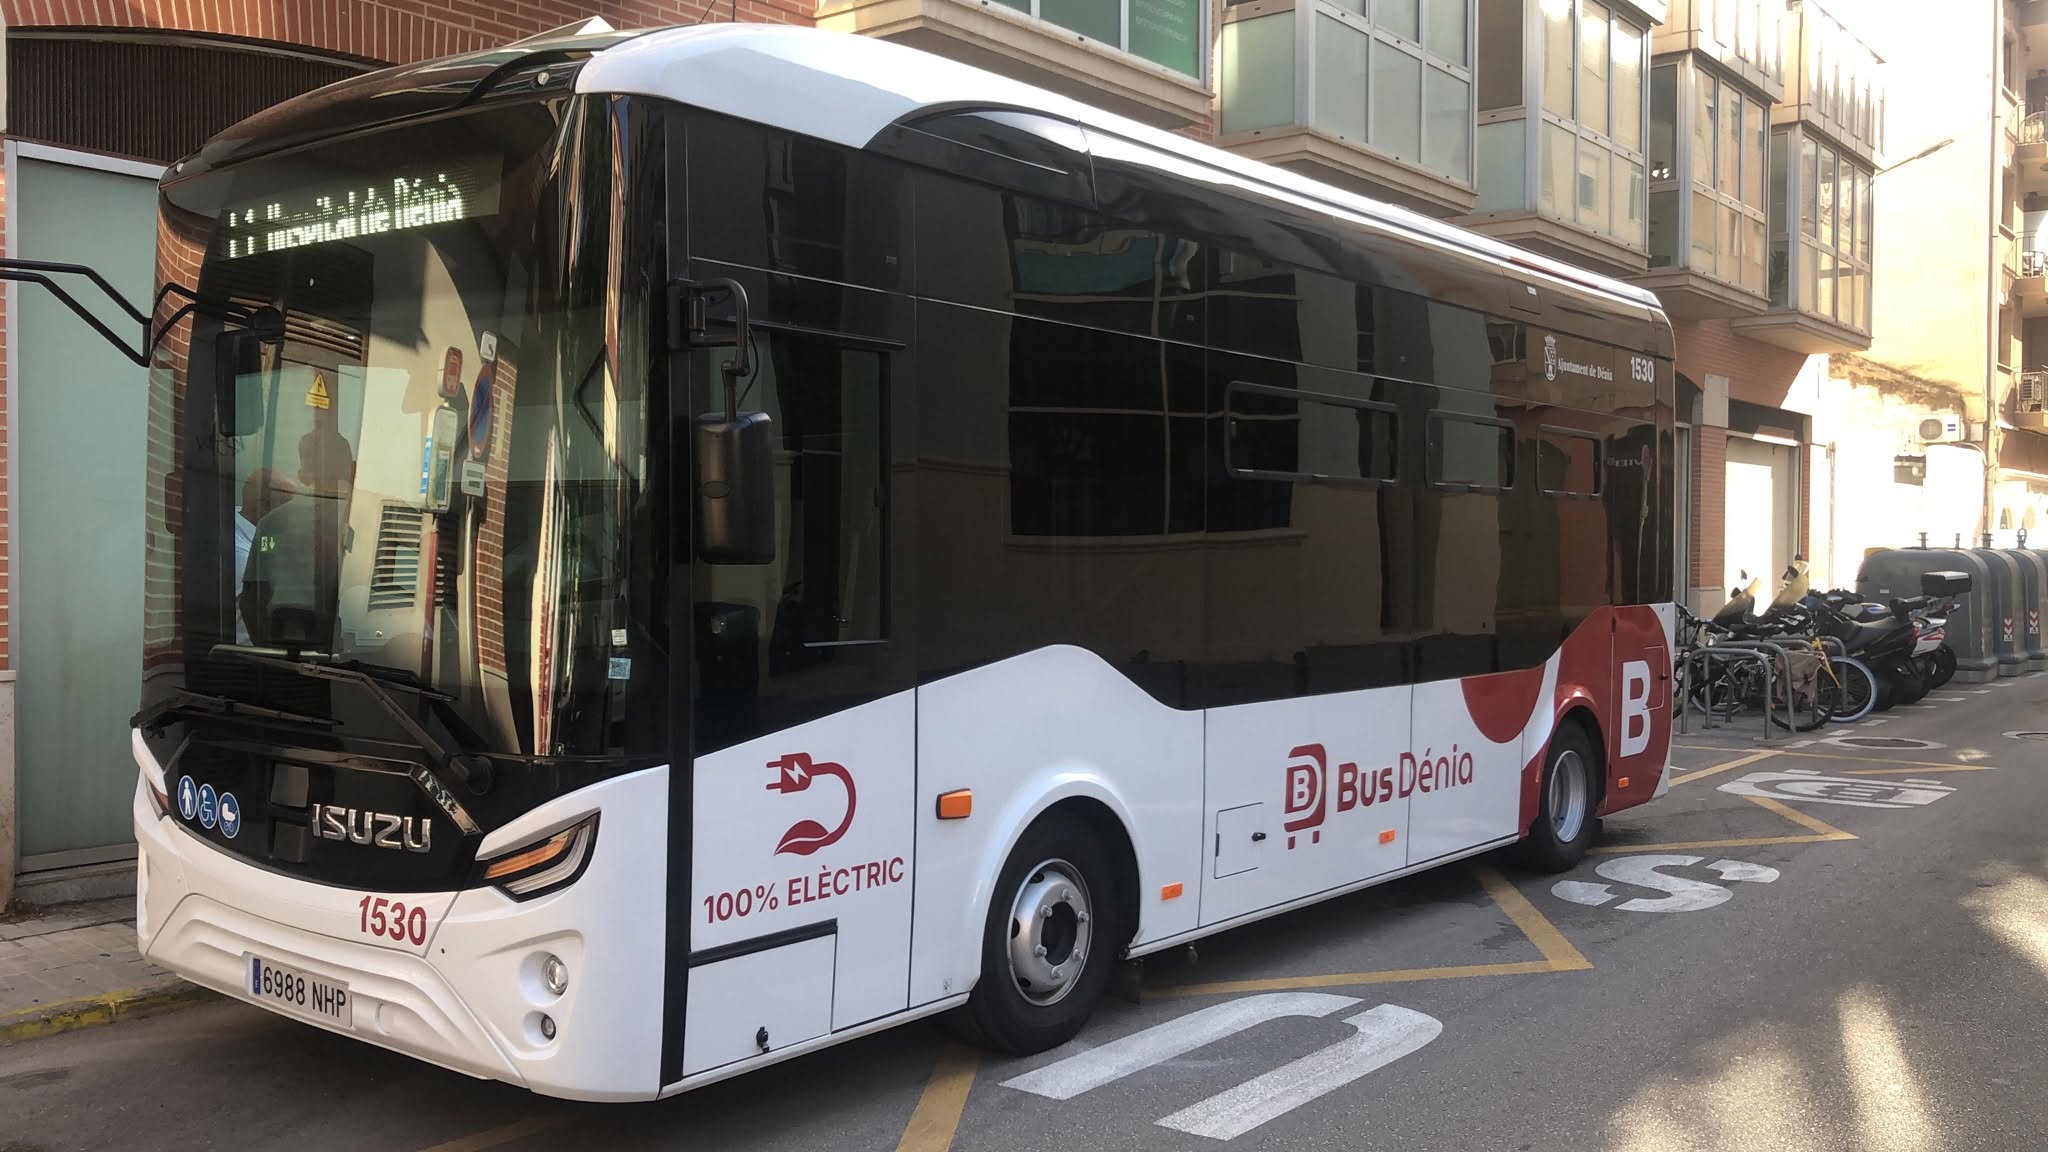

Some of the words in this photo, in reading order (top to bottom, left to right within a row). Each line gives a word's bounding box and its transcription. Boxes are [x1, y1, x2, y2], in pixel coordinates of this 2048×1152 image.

[1588, 363, 1597, 378] de
[1631, 356, 1654, 384] 1530
[1619, 659, 1652, 758] B
[312, 803, 432, 854] ISUZU
[703, 882, 779, 924] 100%
[787, 856, 904, 907] ELÈCTRIC
[358, 895, 427, 946] 1530
[263, 966, 306, 1006] 6988
[312, 981, 347, 1018] NHP
